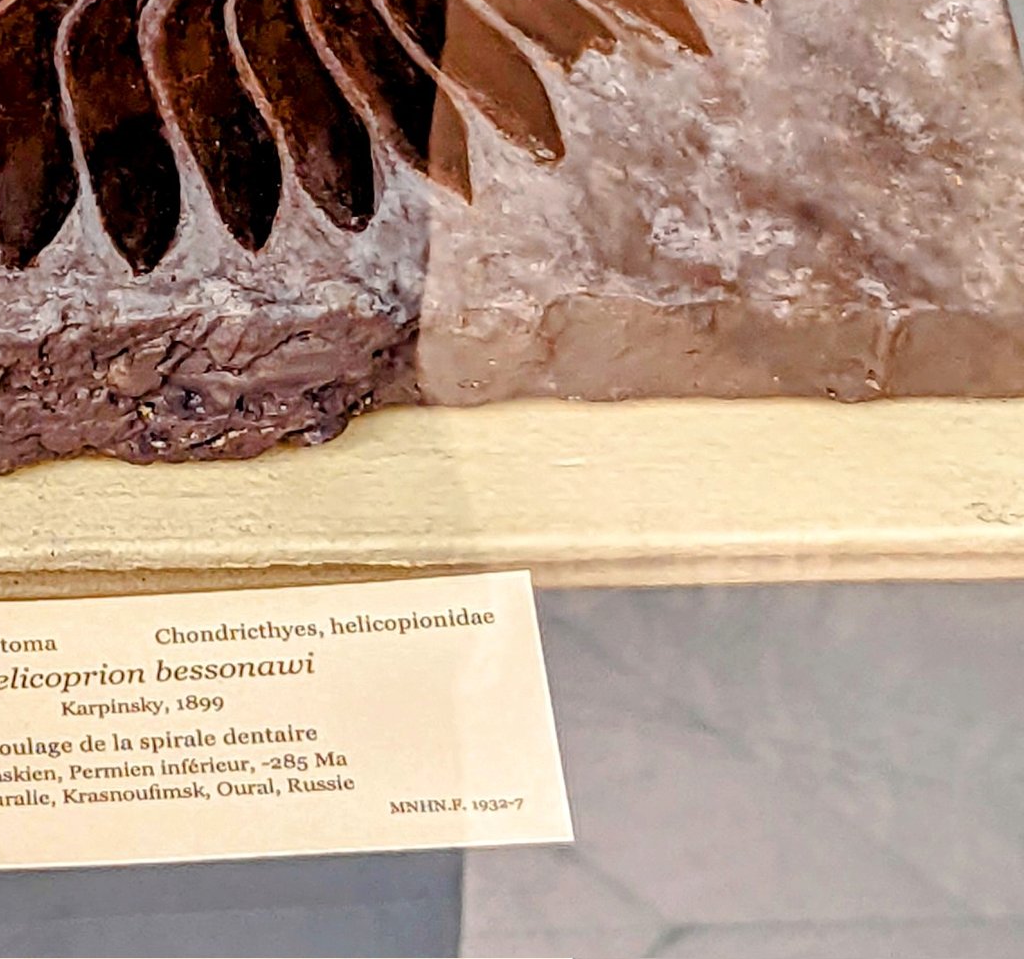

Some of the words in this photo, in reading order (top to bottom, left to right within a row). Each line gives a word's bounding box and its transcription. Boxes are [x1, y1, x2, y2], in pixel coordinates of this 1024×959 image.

[154, 620, 325, 646] Chondricthyes,
[329, 607, 495, 635] helicopionidae
[155, 651, 315, 683] bessonawi
[61, 696, 170, 719] Karpinsky,
[176, 694, 225, 713] 1899
[79, 734, 106, 753] de
[111, 733, 134, 752] la
[139, 728, 217, 754] spirale
[222, 723, 318, 746] dentaire
[68, 761, 155, 781] Permien
[160, 756, 256, 776] inférieur,
[261, 753, 309, 772] -285
[314, 751, 348, 768] Ma
[62, 781, 211, 804] Krasnoufimsk,
[216, 777, 281, 797] Oural,
[286, 774, 355, 794] Russie
[389, 798, 467, 815] MNHN.F.
[472, 797, 524, 812] 1932-7
